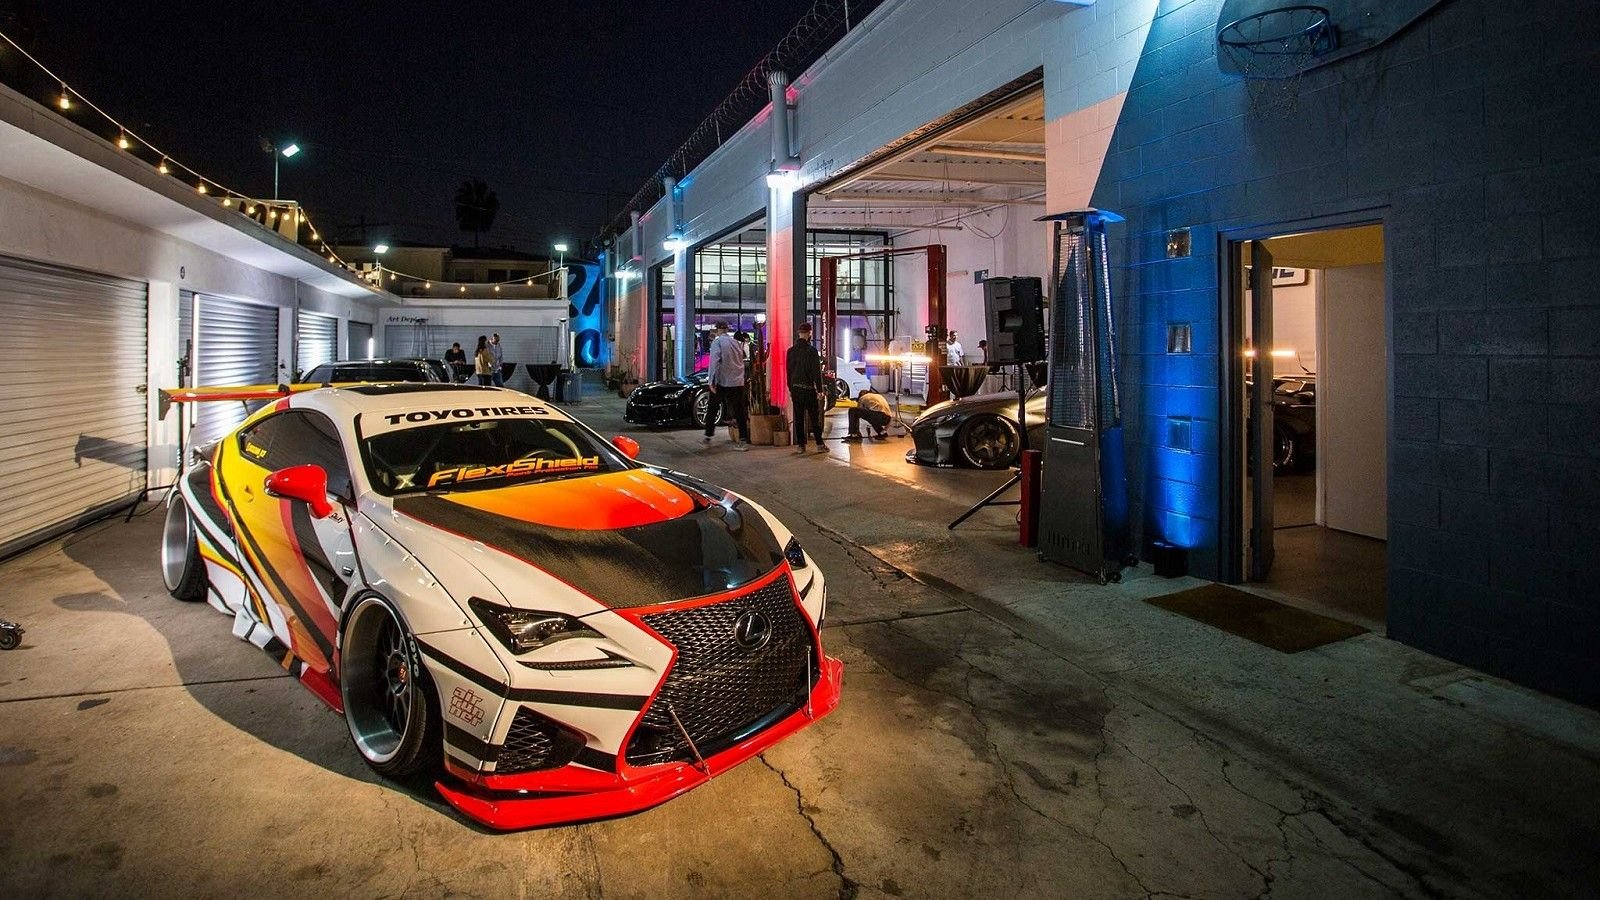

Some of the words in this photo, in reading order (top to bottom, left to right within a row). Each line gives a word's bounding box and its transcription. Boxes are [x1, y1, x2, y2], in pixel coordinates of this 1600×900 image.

[384, 409, 474, 425] TOYO
[475, 406, 549, 416] TIRES
[427, 455, 599, 488] FlexiShield
[452, 686, 483, 706] air
